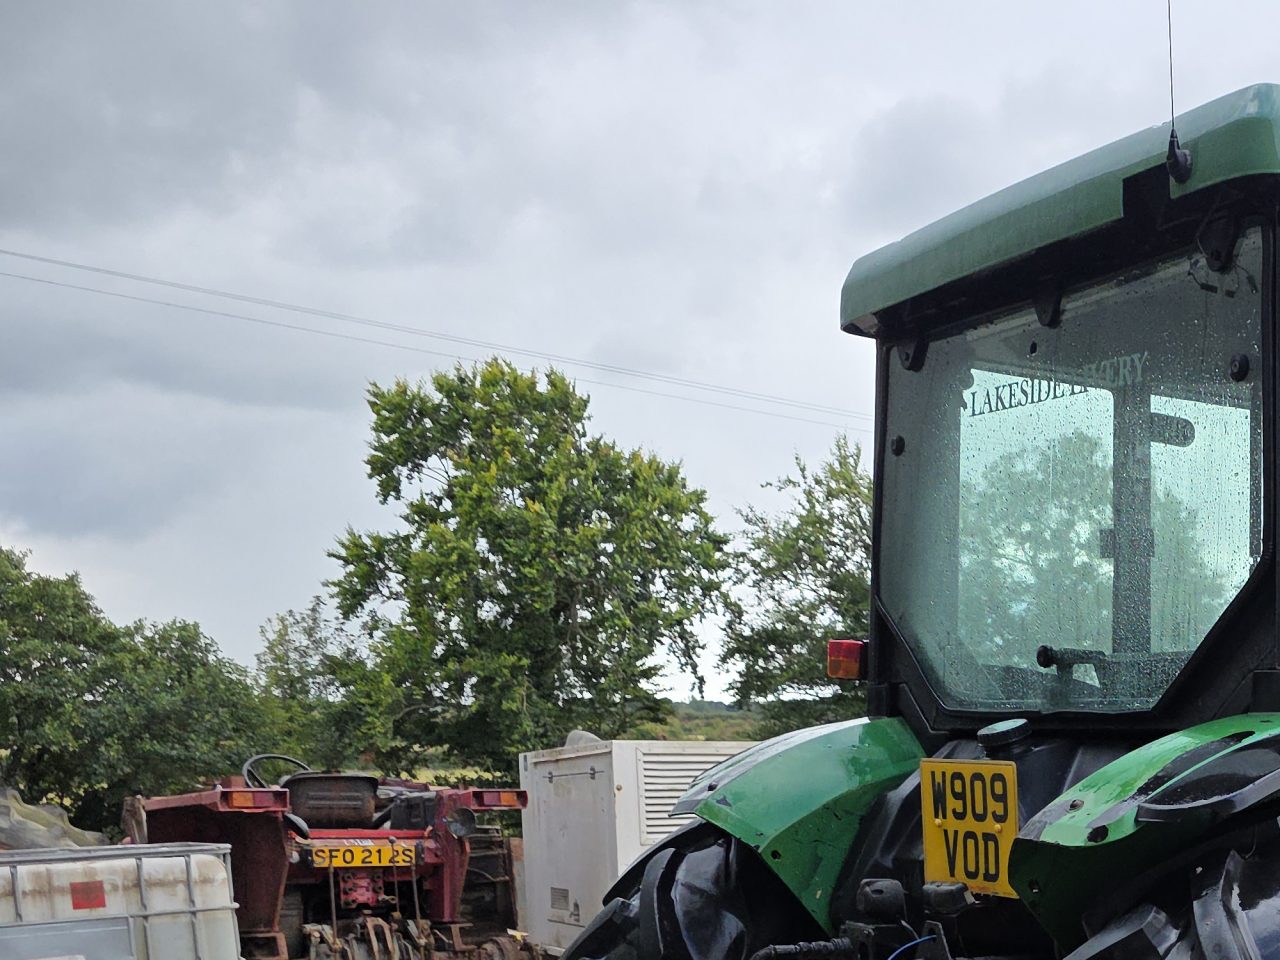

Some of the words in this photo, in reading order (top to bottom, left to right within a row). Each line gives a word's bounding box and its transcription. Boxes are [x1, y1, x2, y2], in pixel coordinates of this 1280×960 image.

[970, 377, 1065, 417] LAKESIDE
[930, 770, 1009, 824] W909
[314, 848, 355, 865] SFO
[943, 828, 1000, 883] VOD
